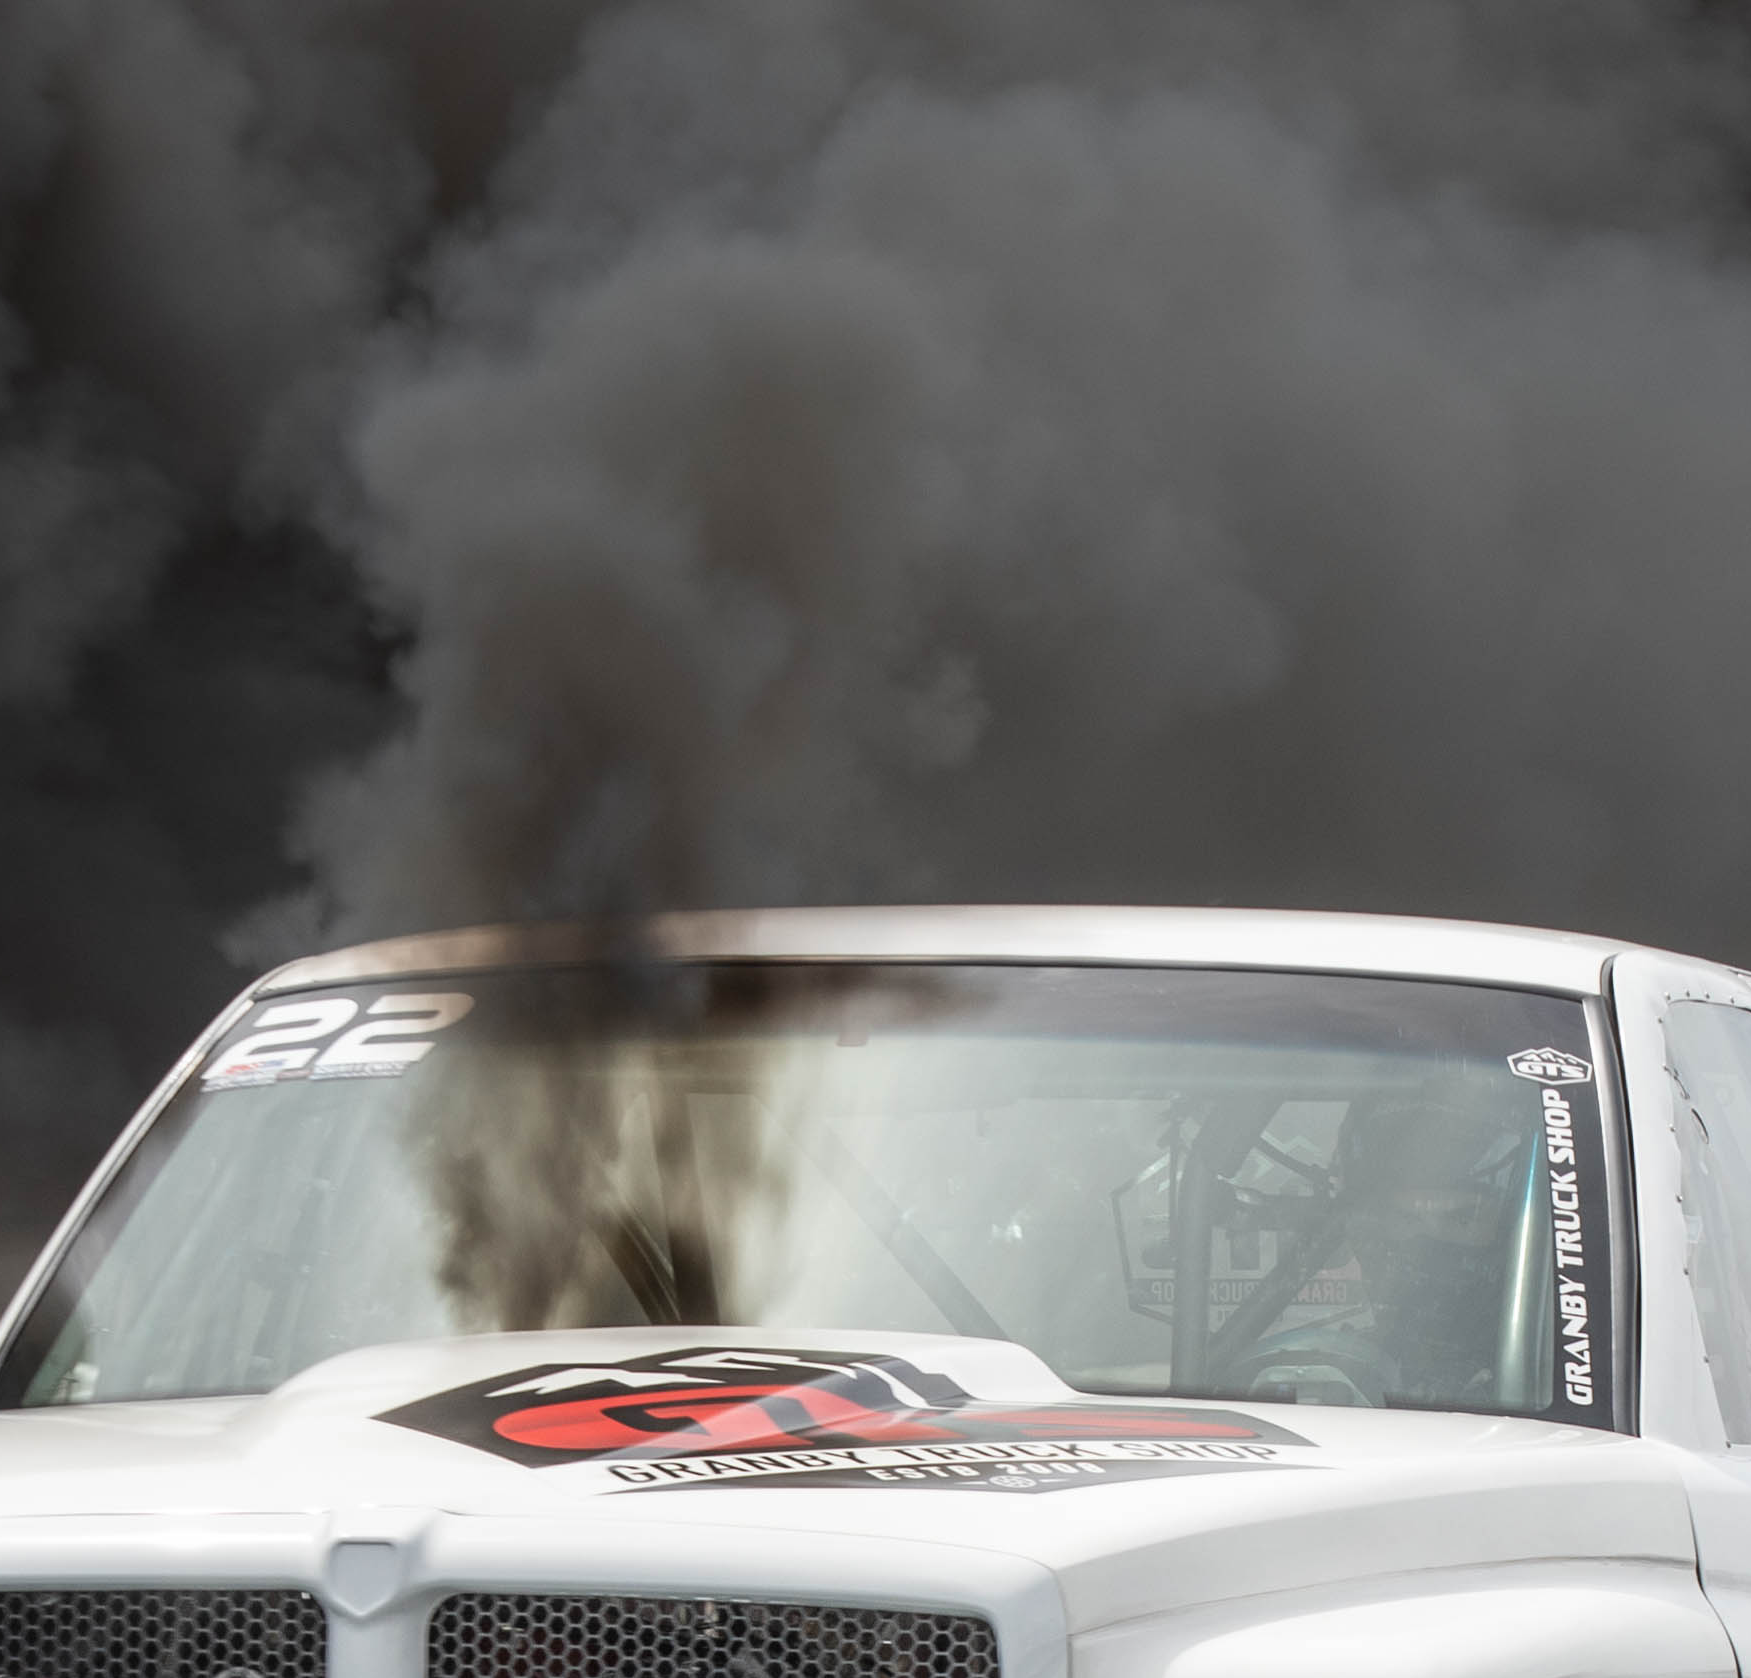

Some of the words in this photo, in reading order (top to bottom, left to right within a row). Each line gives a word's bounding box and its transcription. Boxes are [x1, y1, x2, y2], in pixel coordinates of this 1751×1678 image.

[200, 992, 476, 1080] 22
[1516, 1060, 1586, 1079] GTS
[1541, 1088, 1576, 1166] SHOP
[1549, 1169, 1585, 1269] TRUCK
[1559, 1273, 1594, 1407] GRANBY
[606, 1448, 871, 1484] GRANBY
[881, 1442, 1109, 1466] TRUCK
[1112, 1441, 1280, 1462] SHOP
